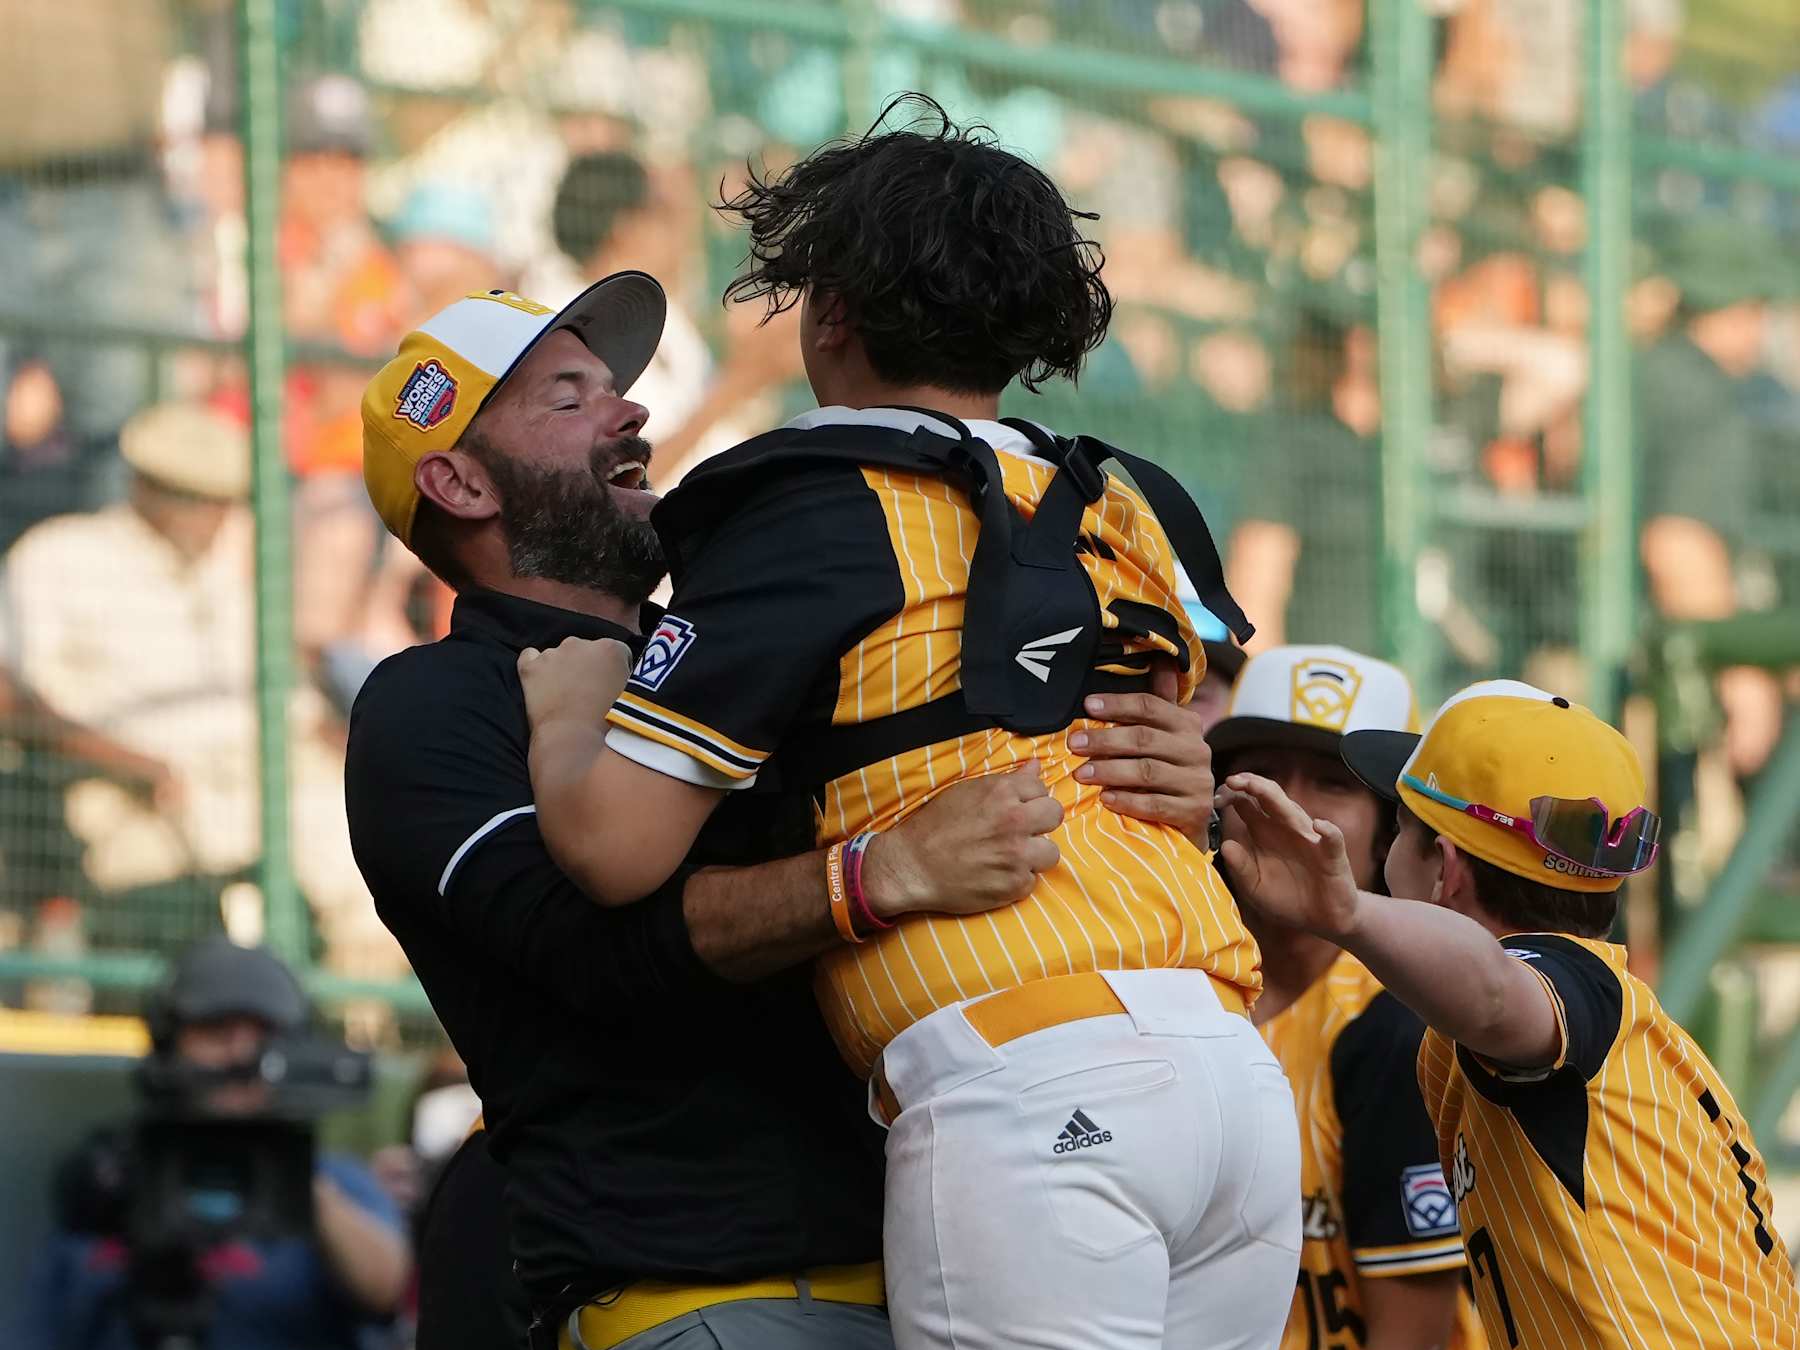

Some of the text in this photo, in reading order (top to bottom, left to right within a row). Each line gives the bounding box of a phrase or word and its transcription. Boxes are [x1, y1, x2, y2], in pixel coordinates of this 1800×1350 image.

[398, 363, 438, 413] WORLD
[410, 372, 447, 421] SERIES
[829, 862, 842, 902] Central
[1052, 1130, 1113, 1154] adidas
